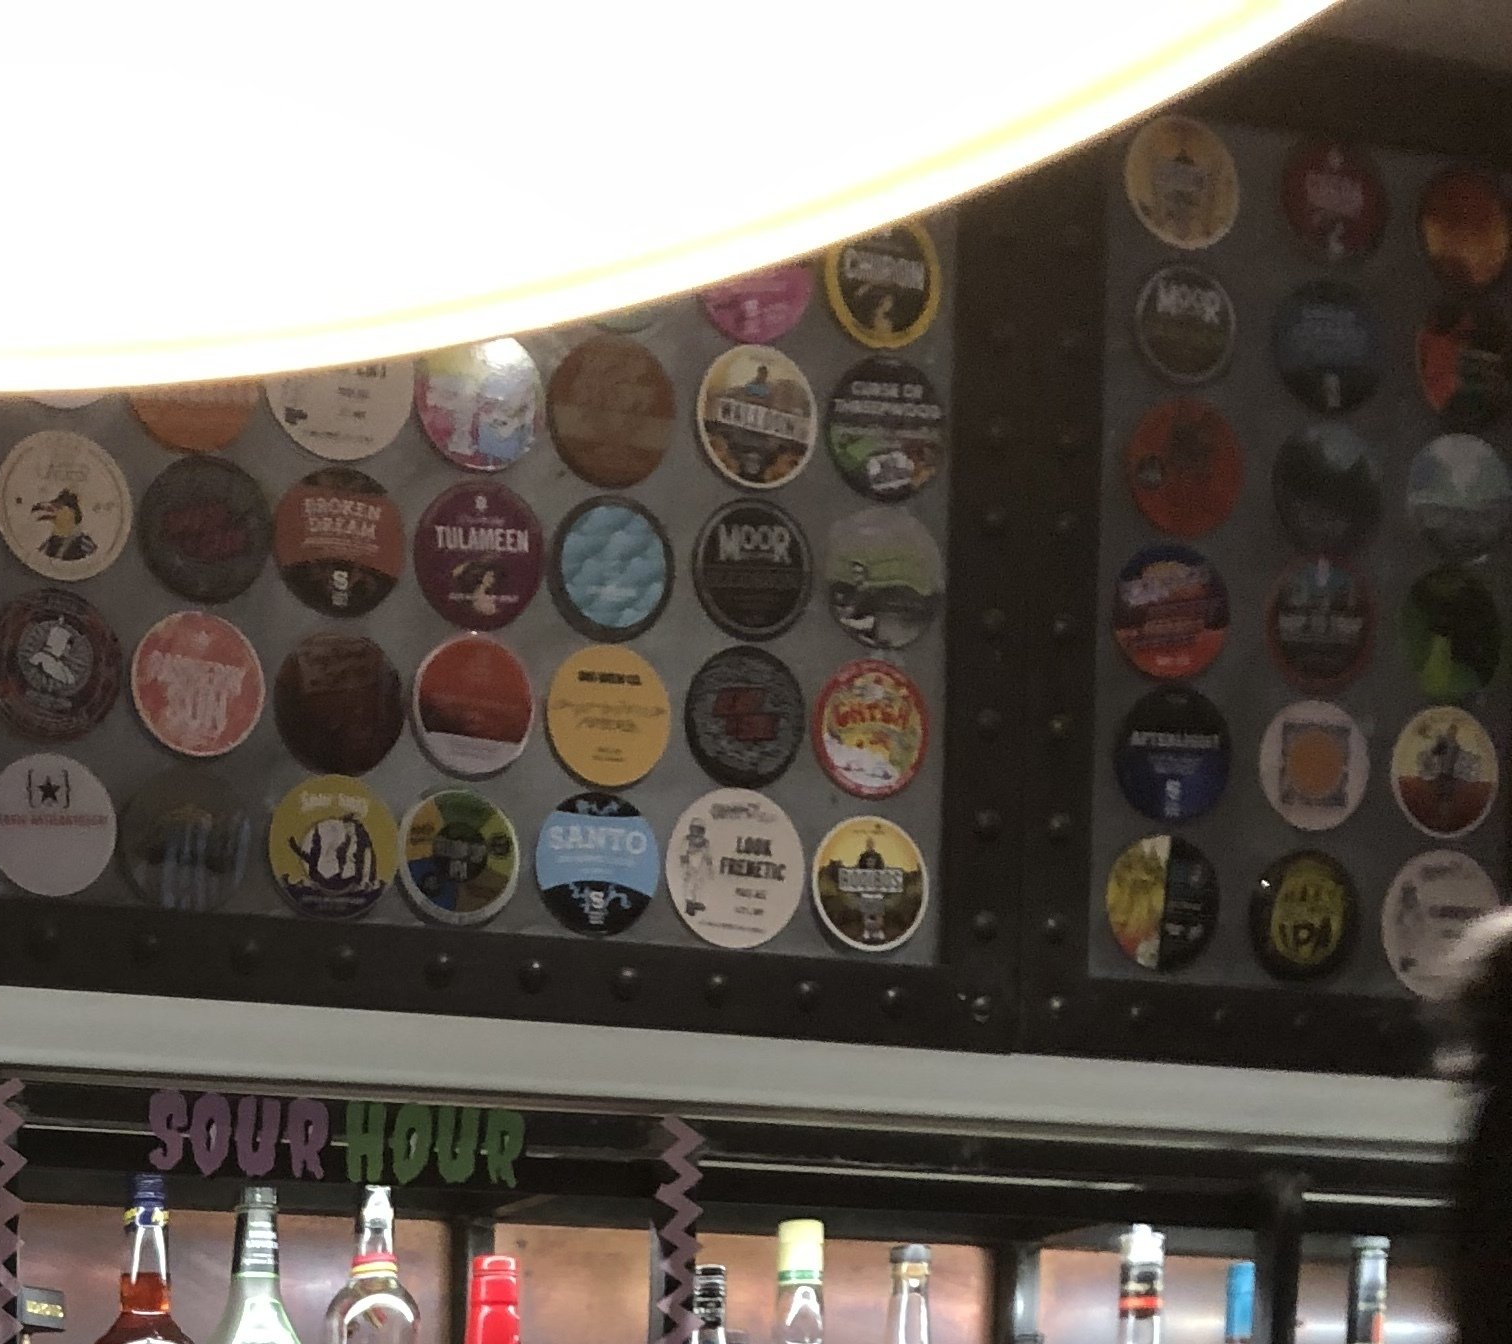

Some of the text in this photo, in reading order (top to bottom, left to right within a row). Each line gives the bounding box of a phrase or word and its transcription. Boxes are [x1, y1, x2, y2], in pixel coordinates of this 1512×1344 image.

[303, 497, 383, 521] BROKEN
[308, 517, 377, 540] DREAM
[433, 524, 530, 553] TULAMEEN
[718, 523, 792, 563] MOOR
[548, 825, 647, 854] SANTO
[148, 1090, 526, 1188] SOUR HOUR
